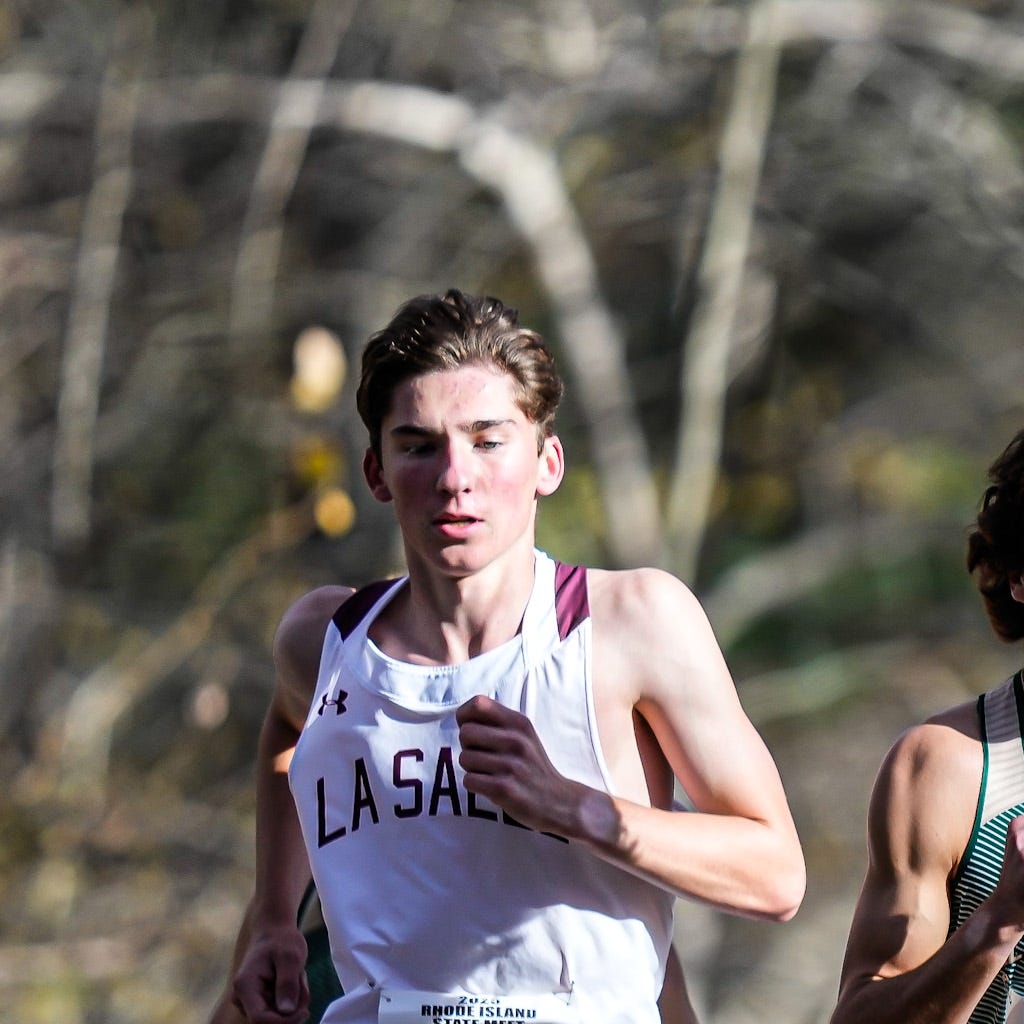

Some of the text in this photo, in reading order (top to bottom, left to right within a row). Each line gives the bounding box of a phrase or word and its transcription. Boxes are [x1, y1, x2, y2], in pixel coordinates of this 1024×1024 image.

[316, 757, 380, 848] LA
[421, 1005, 536, 1018] RHODE ISLAND
